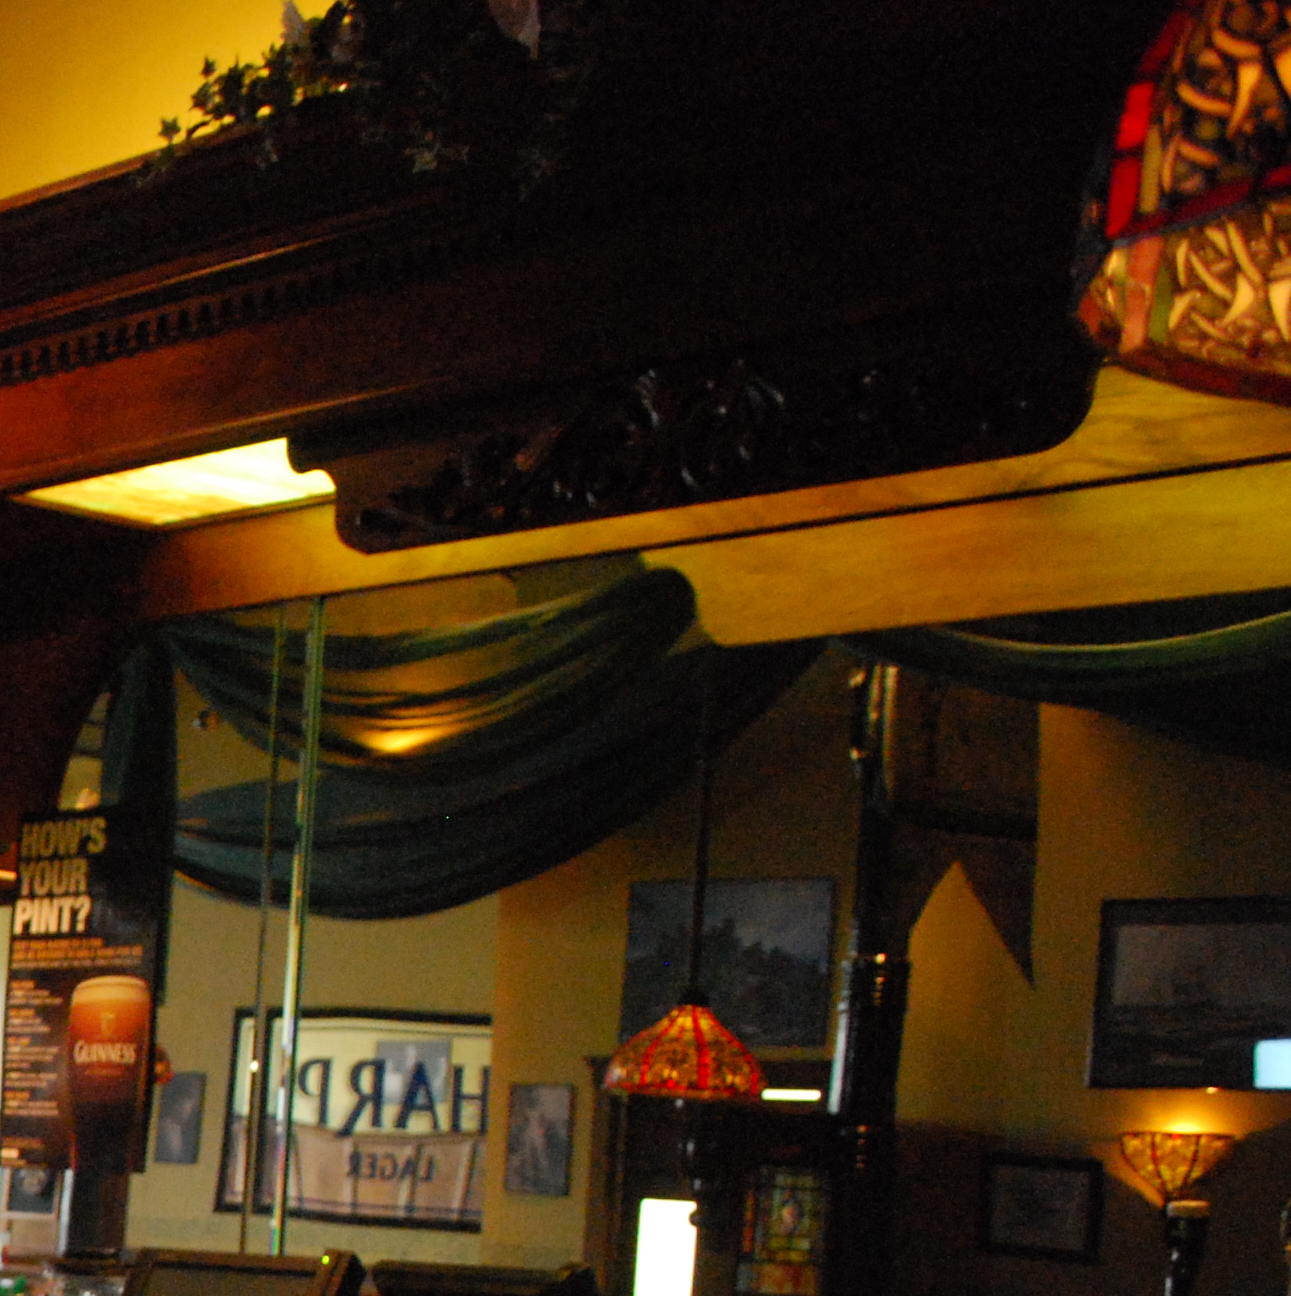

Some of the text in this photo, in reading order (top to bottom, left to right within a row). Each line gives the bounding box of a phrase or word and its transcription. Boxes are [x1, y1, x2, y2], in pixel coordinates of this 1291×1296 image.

[20, 815, 108, 858] HOW'S
[19, 858, 90, 896] YOUR
[13, 894, 92, 935] PINT?
[74, 1040, 137, 1065] GUINNESS
